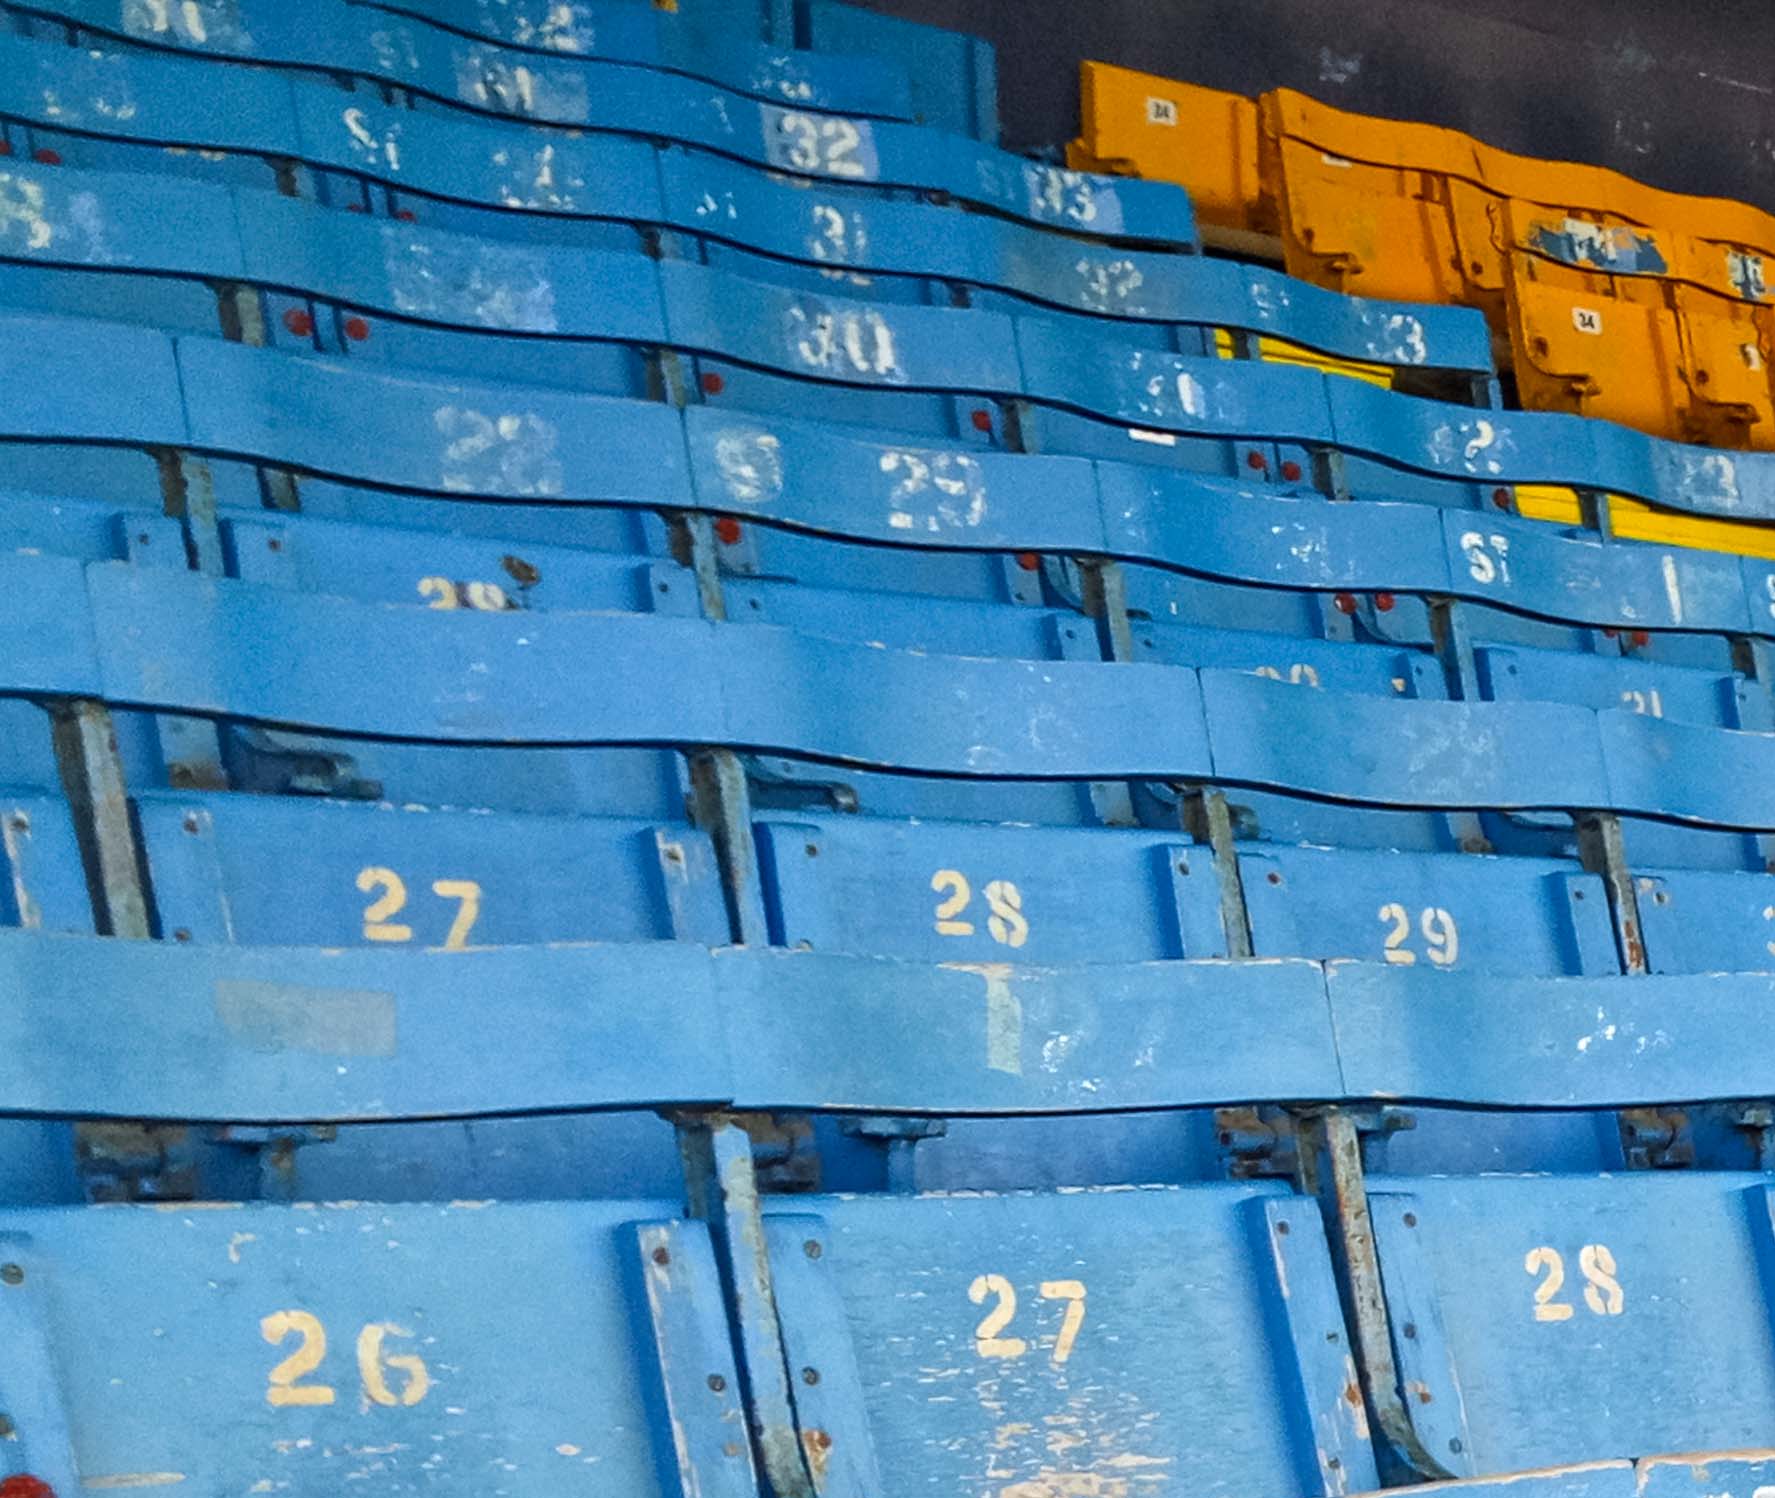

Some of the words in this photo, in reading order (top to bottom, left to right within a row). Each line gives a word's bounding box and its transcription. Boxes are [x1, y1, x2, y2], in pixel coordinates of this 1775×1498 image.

[782, 111, 866, 176] 32
[357, 868, 481, 950] 27
[932, 870, 1028, 947] 28
[1379, 904, 1457, 966] 29
[969, 1274, 1086, 1362] 27
[1525, 1245, 1623, 1321] 28
[261, 1310, 436, 1406] 26
